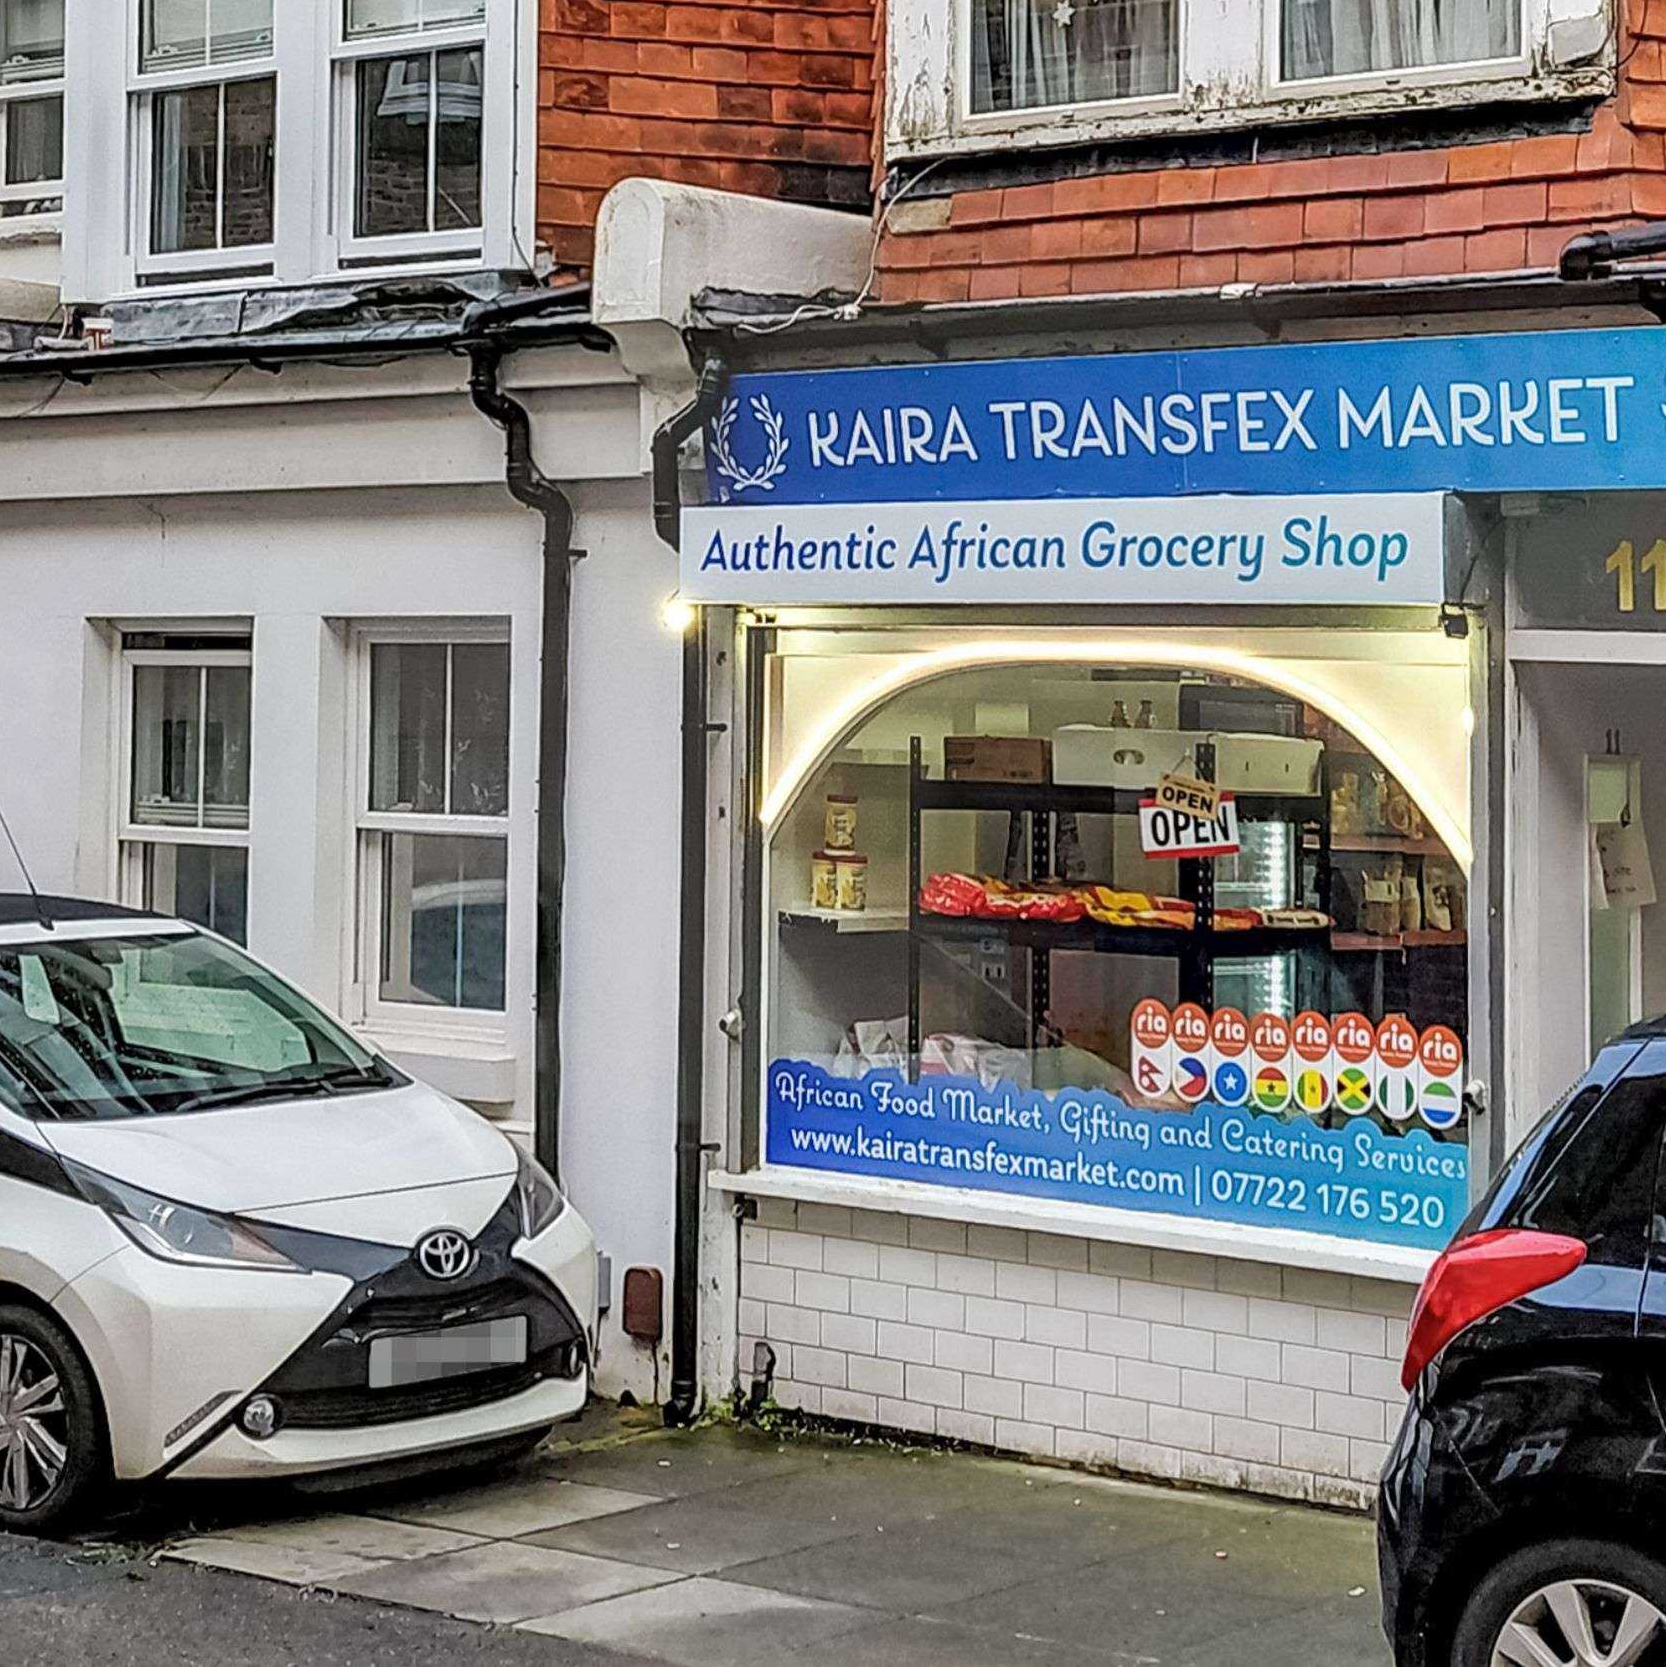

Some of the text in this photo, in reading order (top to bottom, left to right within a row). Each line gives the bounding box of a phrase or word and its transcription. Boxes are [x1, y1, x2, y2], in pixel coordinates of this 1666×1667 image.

[807, 376, 1634, 467] KAIRA TRANSFEX MARKET
[699, 515, 1410, 583] Authentic African Grocery Shop
[1162, 785, 1214, 814] OPEN
[1150, 805, 1231, 847] OPEN
[1136, 1005, 1167, 1034] ria
[1175, 1009, 1207, 1037] ria
[1214, 1013, 1246, 1041] ria
[1254, 1017, 1288, 1046] ria
[1295, 1017, 1329, 1046] ria
[1337, 1018, 1371, 1048] ria
[1380, 1022, 1414, 1053] ria
[1423, 1032, 1458, 1061] ria
[775, 1071, 1467, 1180] African Food Market, Gifting and Catering Services
[790, 1125, 1186, 1196] www.kairatransfexmarket.com
[1211, 1168, 1308, 1213] 07722
[1315, 1182, 1371, 1220] 176
[1378, 1190, 1445, 1229] 520
